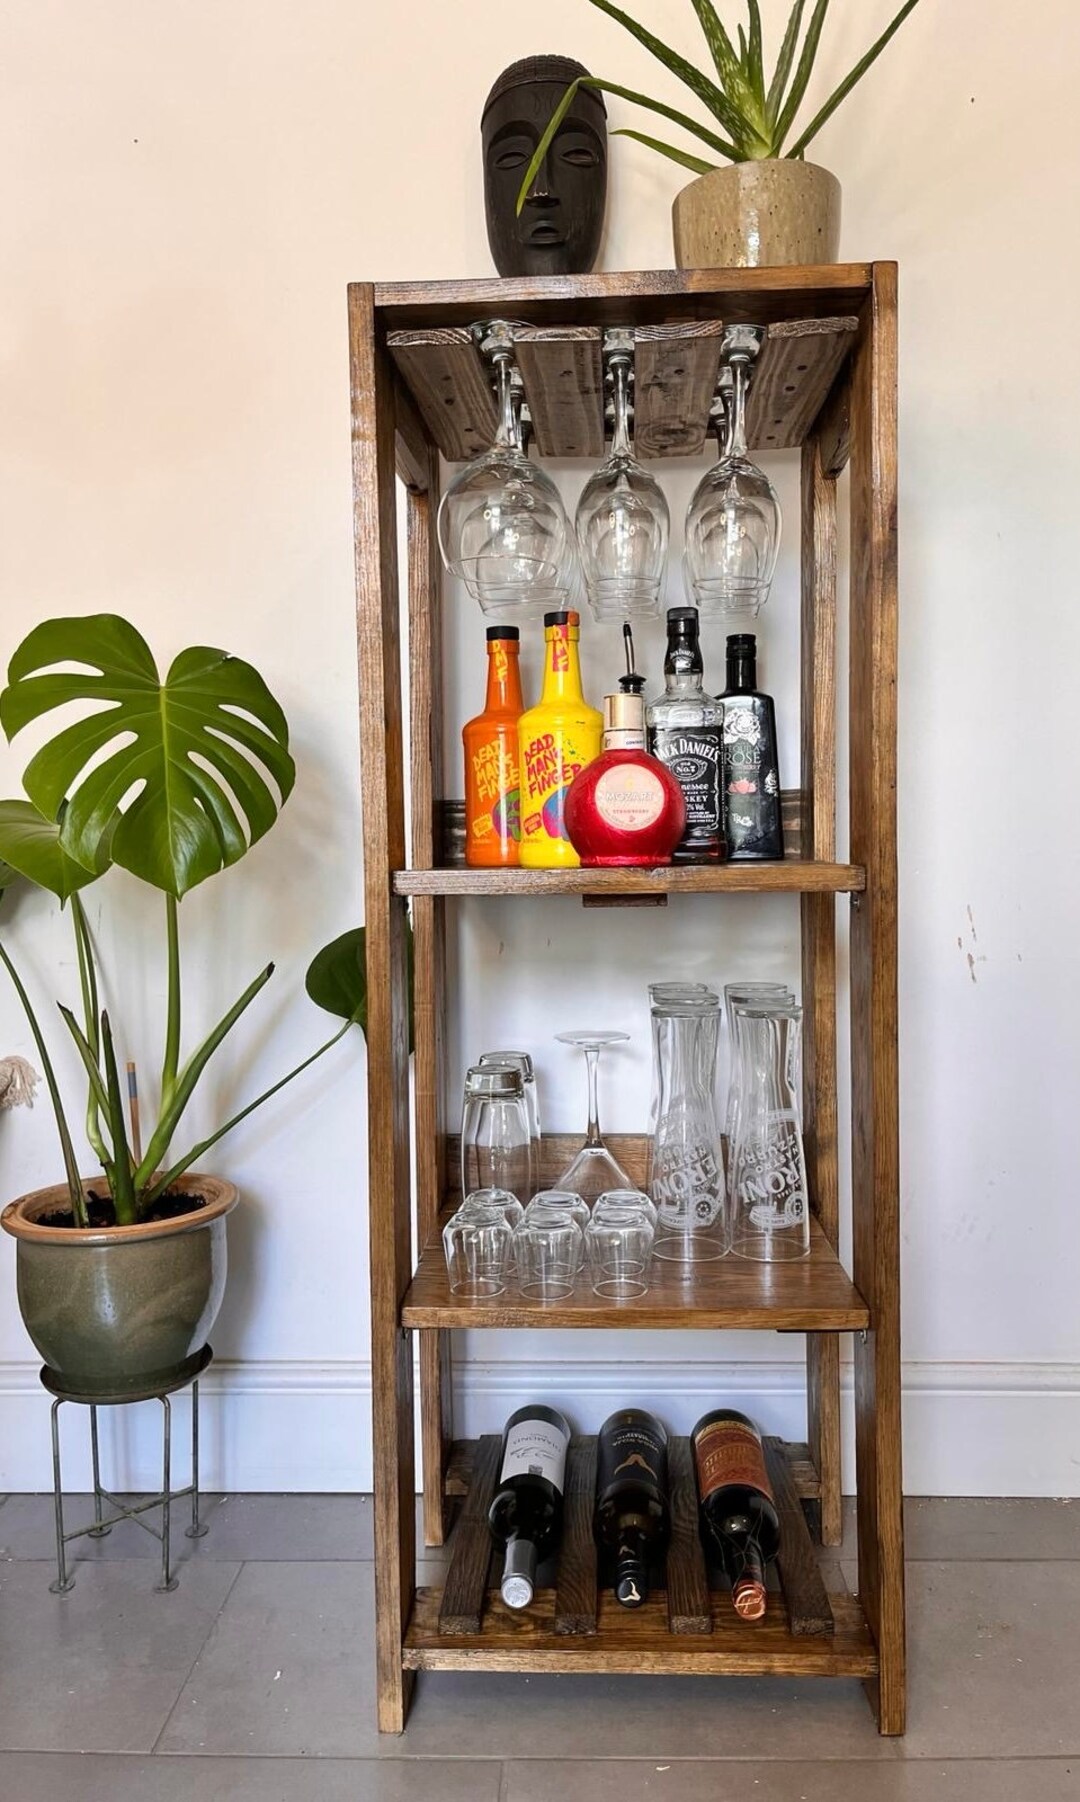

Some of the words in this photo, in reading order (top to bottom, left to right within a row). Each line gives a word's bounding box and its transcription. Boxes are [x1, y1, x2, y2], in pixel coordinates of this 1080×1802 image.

[524, 733, 555, 766] DEAD
[724, 751, 762, 766] ROSE
[478, 767, 520, 803] FINGE
[528, 763, 582, 799] FINGER
[739, 1159, 801, 1203] RONI
